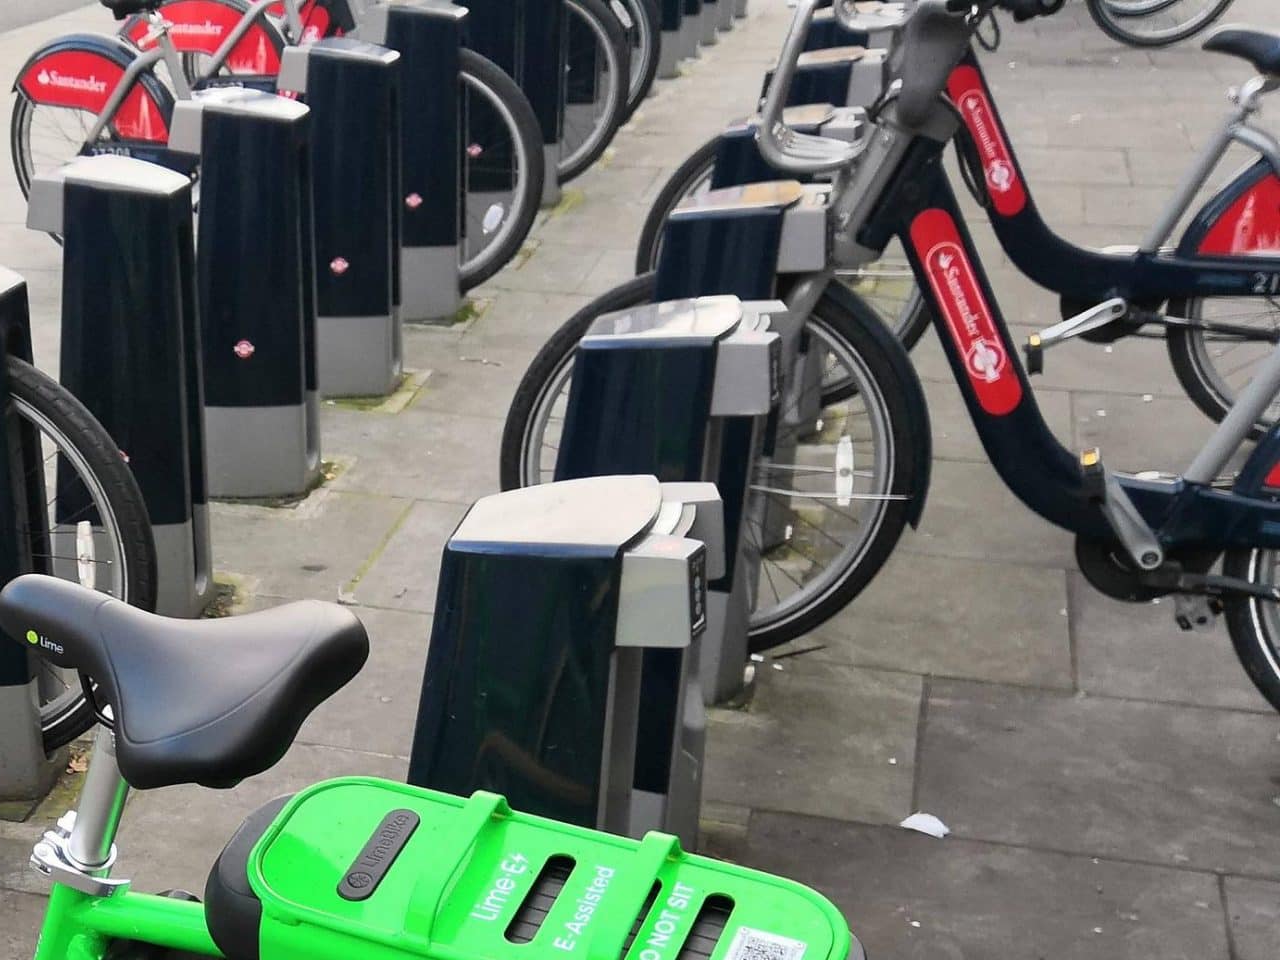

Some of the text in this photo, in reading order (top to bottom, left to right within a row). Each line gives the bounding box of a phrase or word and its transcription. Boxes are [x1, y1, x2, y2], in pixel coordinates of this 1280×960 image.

[170, 20, 224, 35] antander
[49, 69, 107, 93] Santander
[40, 635, 65, 655] Lime
[552, 865, 616, 952] E-Assisted
[652, 909, 683, 948] NOT
[669, 881, 697, 911] SIT
